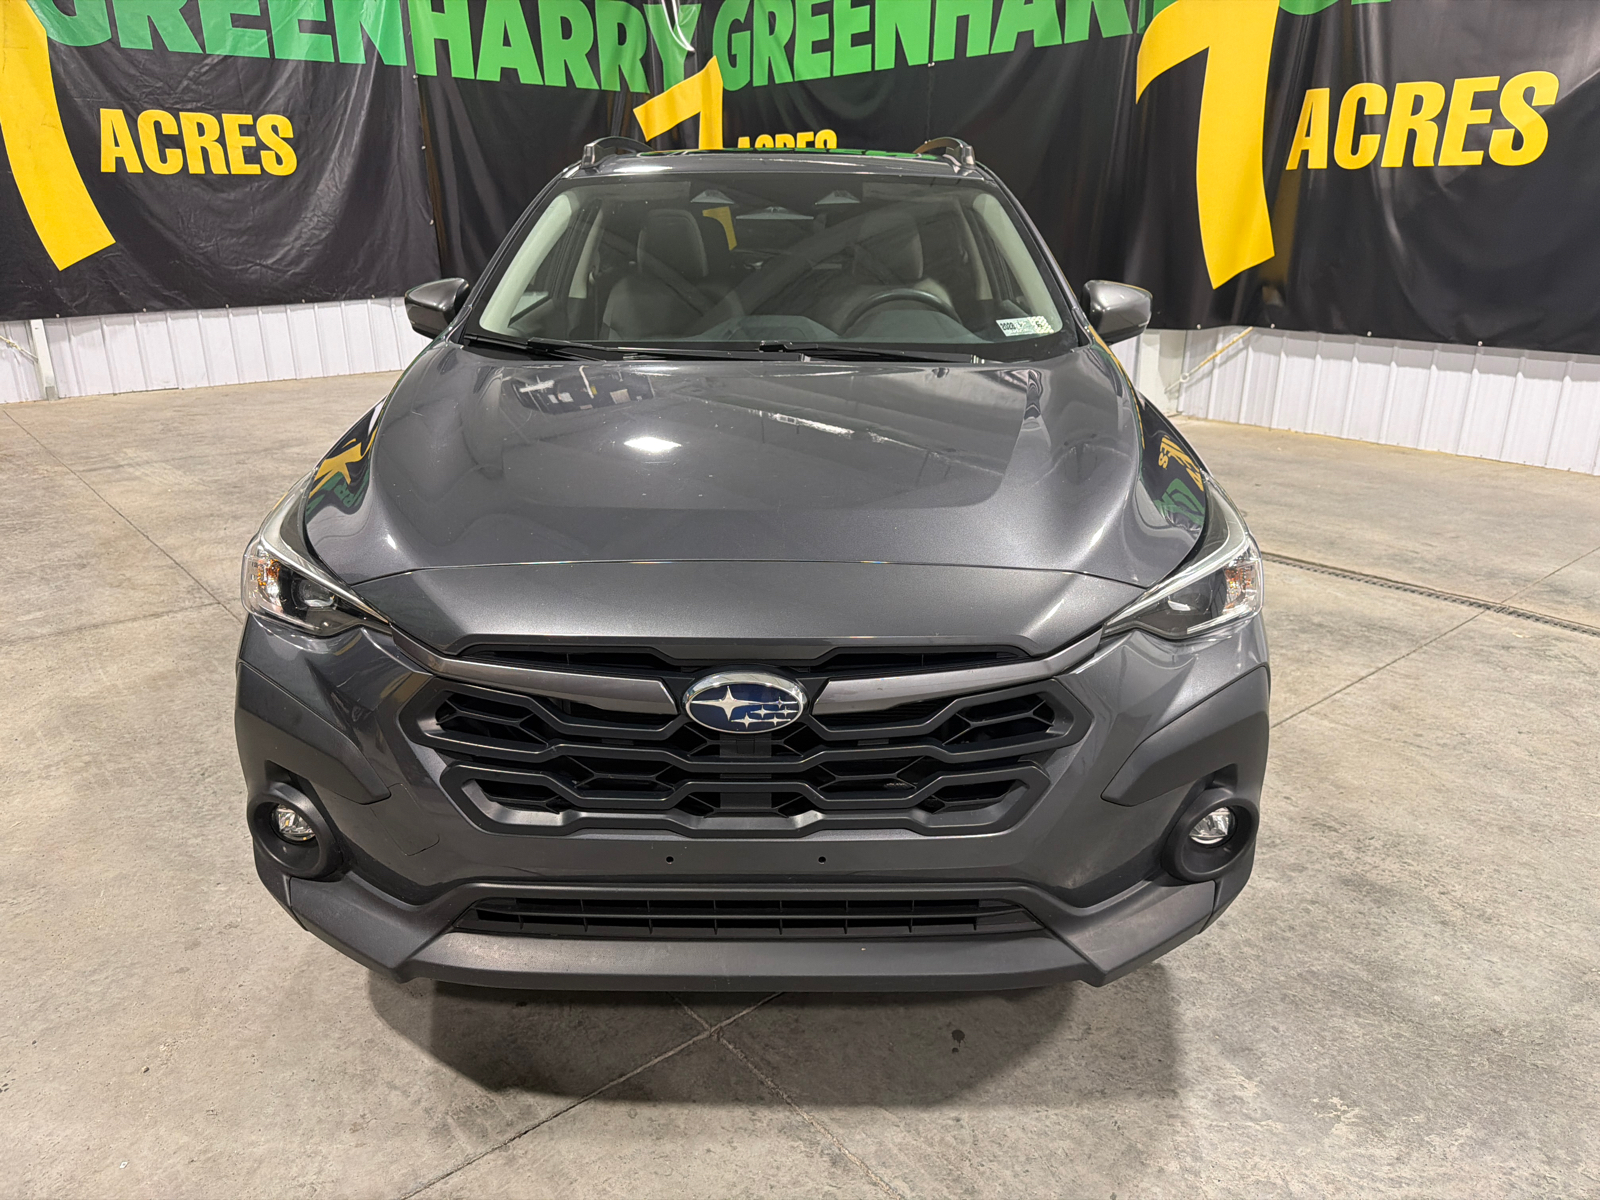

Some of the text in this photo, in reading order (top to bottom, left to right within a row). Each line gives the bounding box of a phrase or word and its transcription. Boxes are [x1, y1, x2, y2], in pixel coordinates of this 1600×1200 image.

[408, 0, 702, 94] HARRY
[712, 0, 930, 92] GREEN
[99, 107, 298, 176] ACRES
[1285, 70, 1559, 171] ACRES
